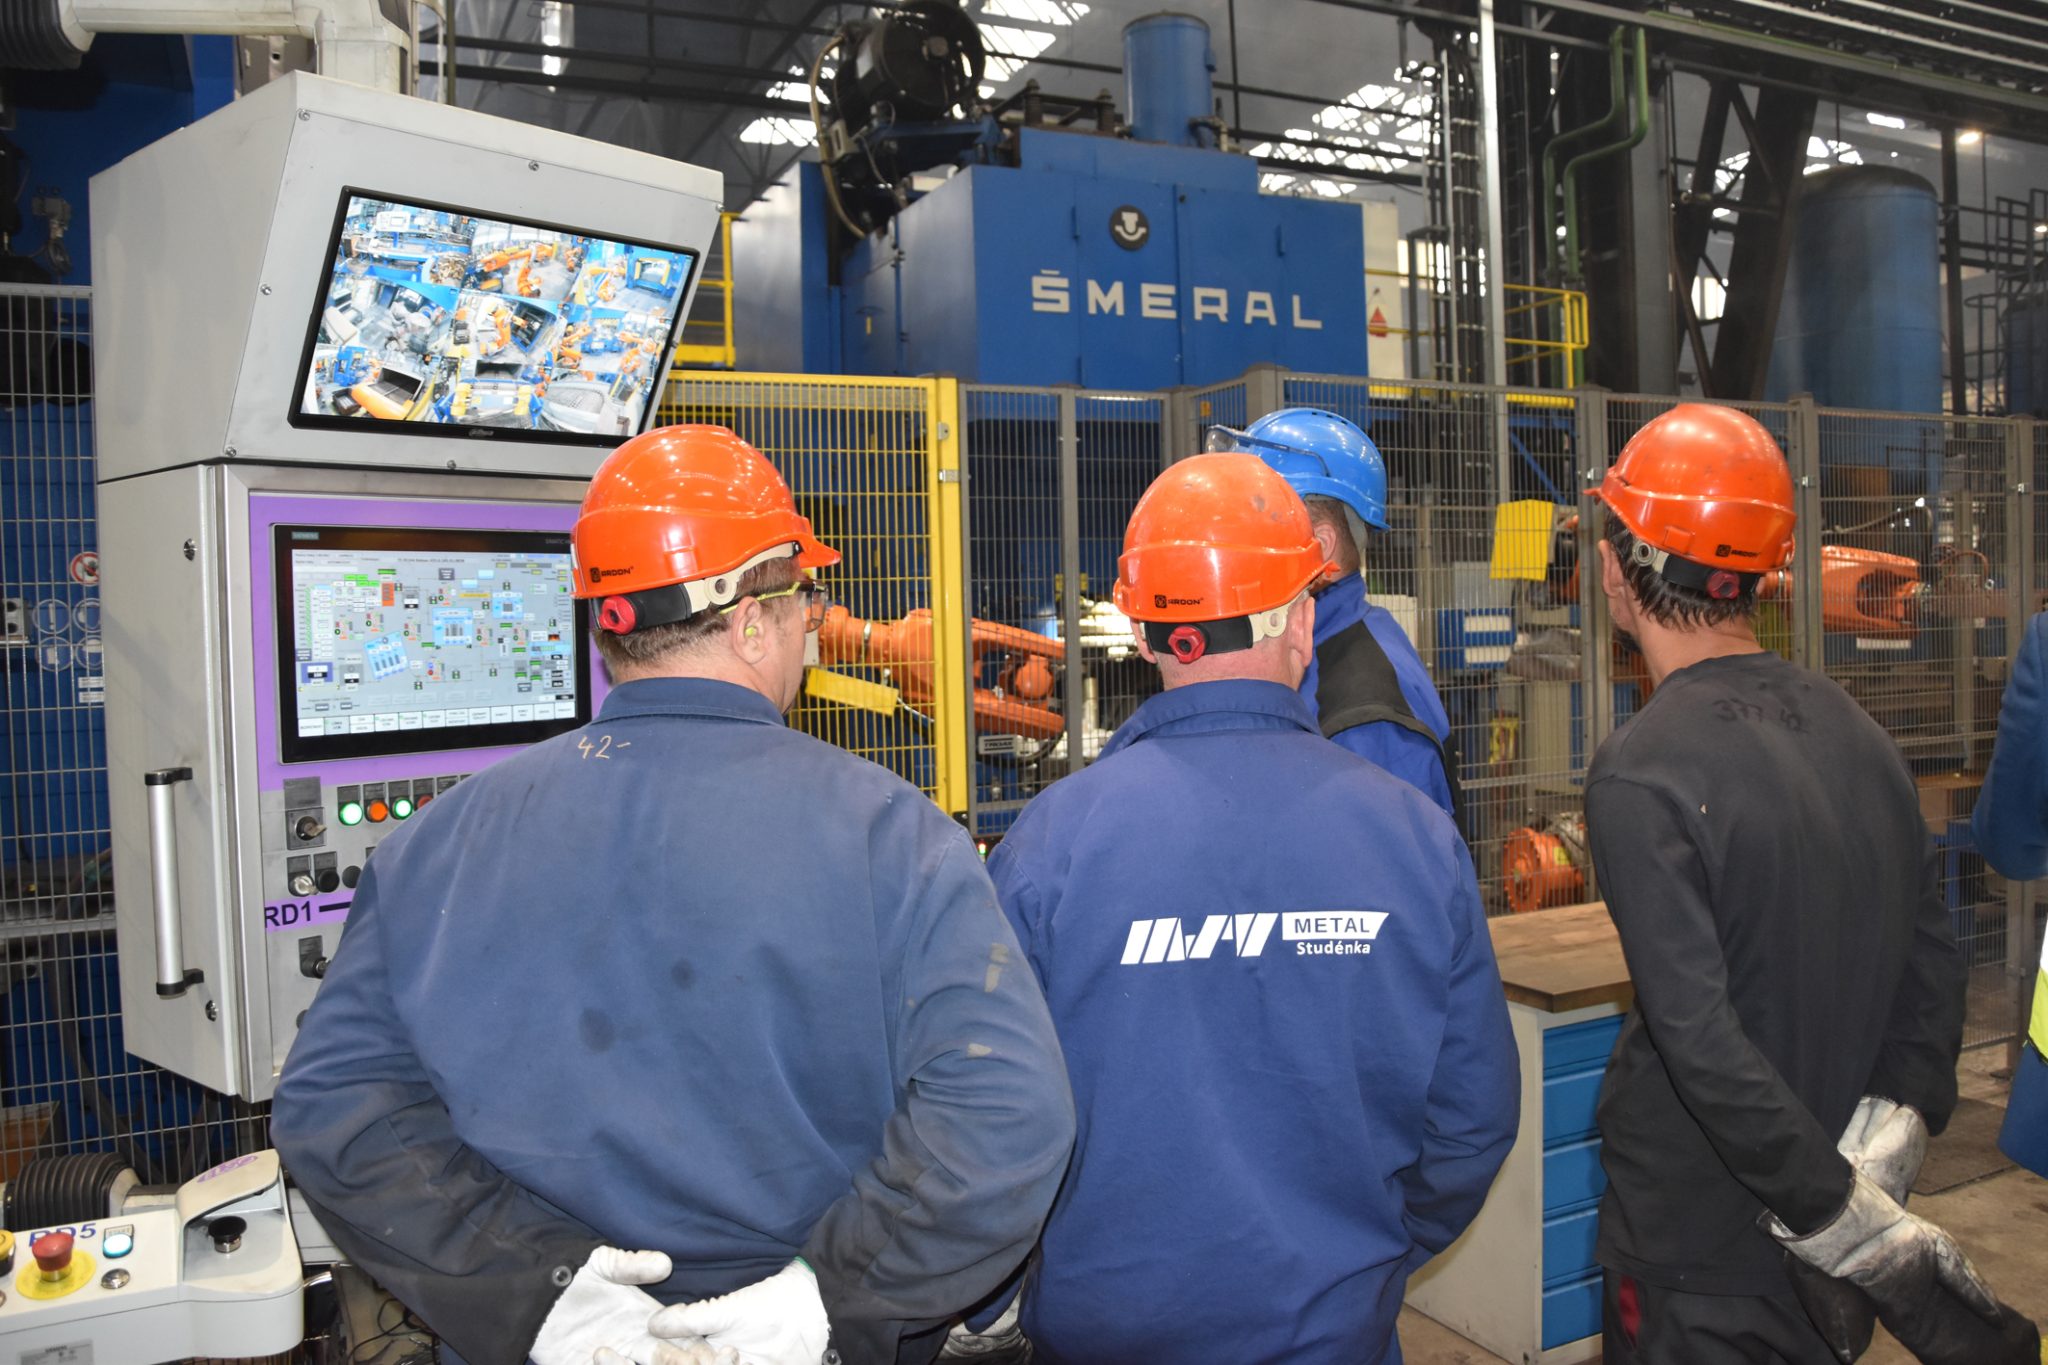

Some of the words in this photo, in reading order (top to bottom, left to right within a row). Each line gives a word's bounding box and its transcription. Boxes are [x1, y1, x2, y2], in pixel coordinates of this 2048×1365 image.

[1031, 269, 1323, 330] ŠMERAL
[264, 901, 312, 928] RD1
[1294, 916, 1371, 934] METAL
[1296, 940, 1371, 956] Studénka
